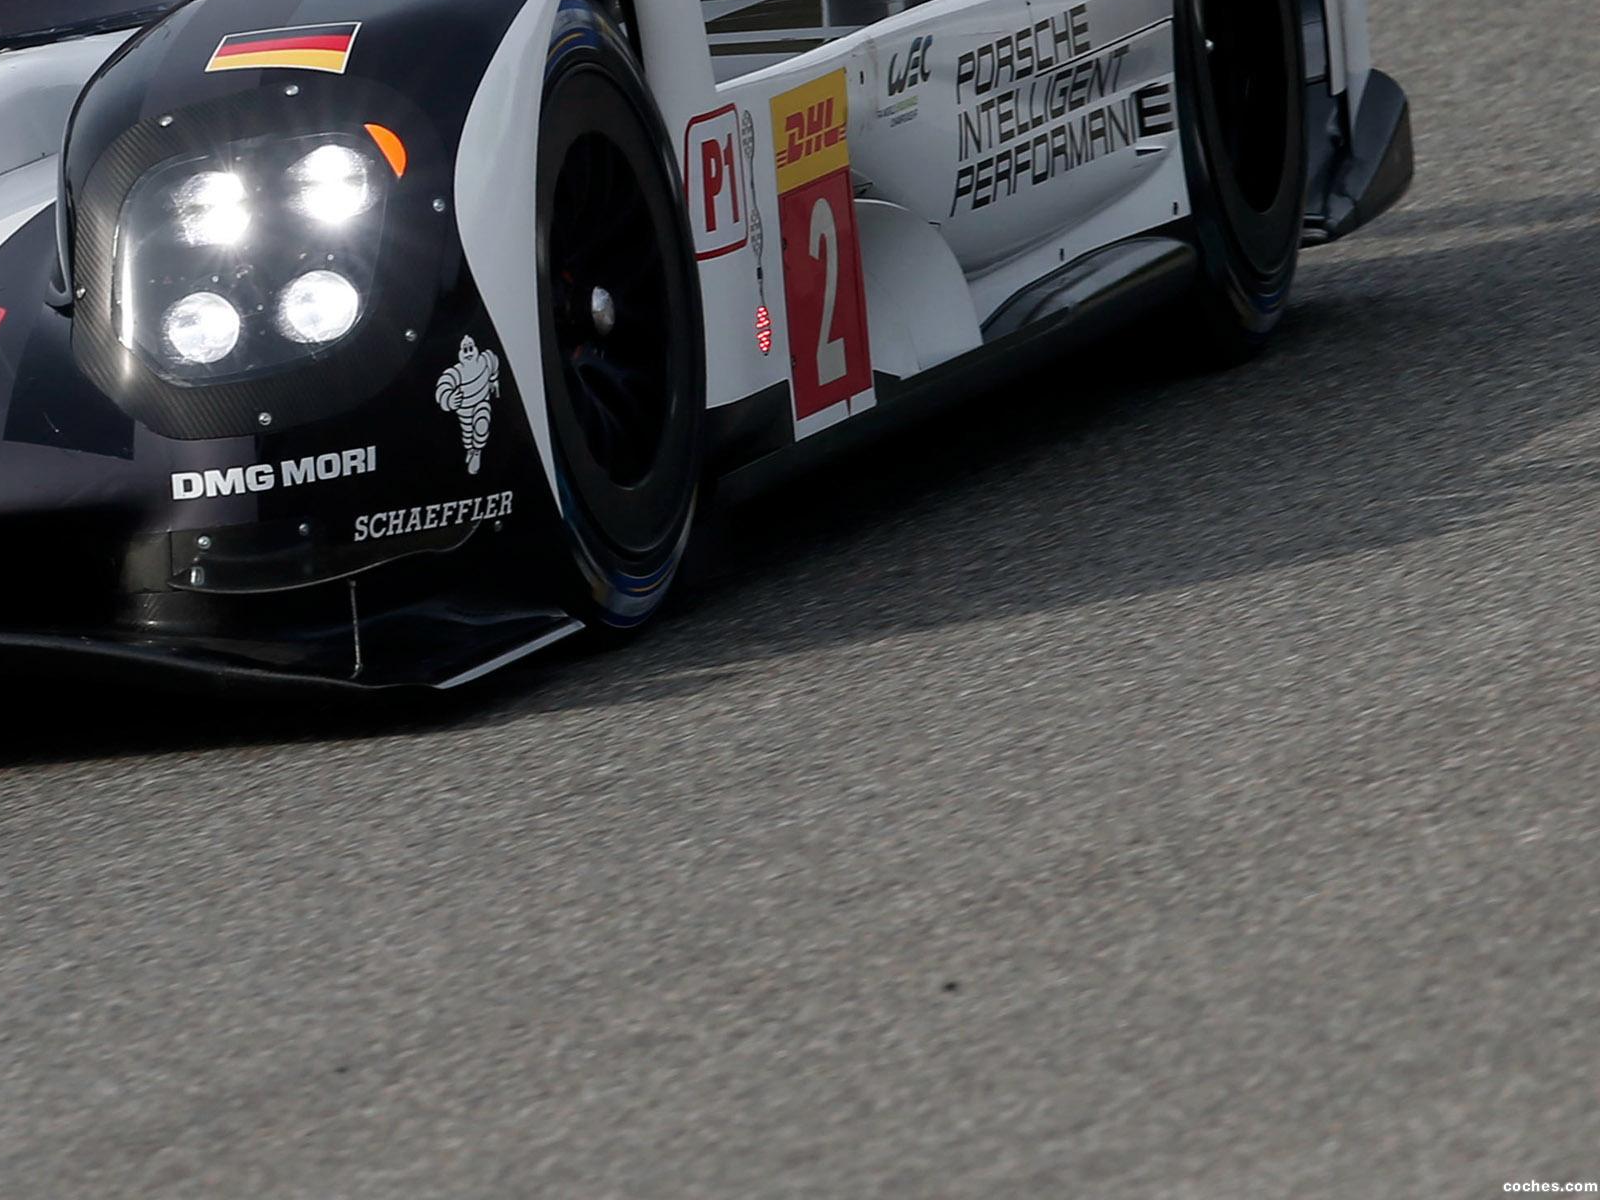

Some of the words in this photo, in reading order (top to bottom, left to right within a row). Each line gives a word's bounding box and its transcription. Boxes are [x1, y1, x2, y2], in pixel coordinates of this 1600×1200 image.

[888, 34, 933, 96] WEC
[955, 3, 1091, 105] PORSCHE
[957, 44, 1130, 162] INTELLIGENT
[784, 96, 840, 165] DHL
[950, 83, 1175, 218] PERFORMANE
[701, 133, 740, 232] P1
[808, 197, 847, 387] 2
[171, 463, 275, 500] DMG
[282, 446, 377, 487] MORI
[354, 490, 514, 542] SCHAEFFLER
